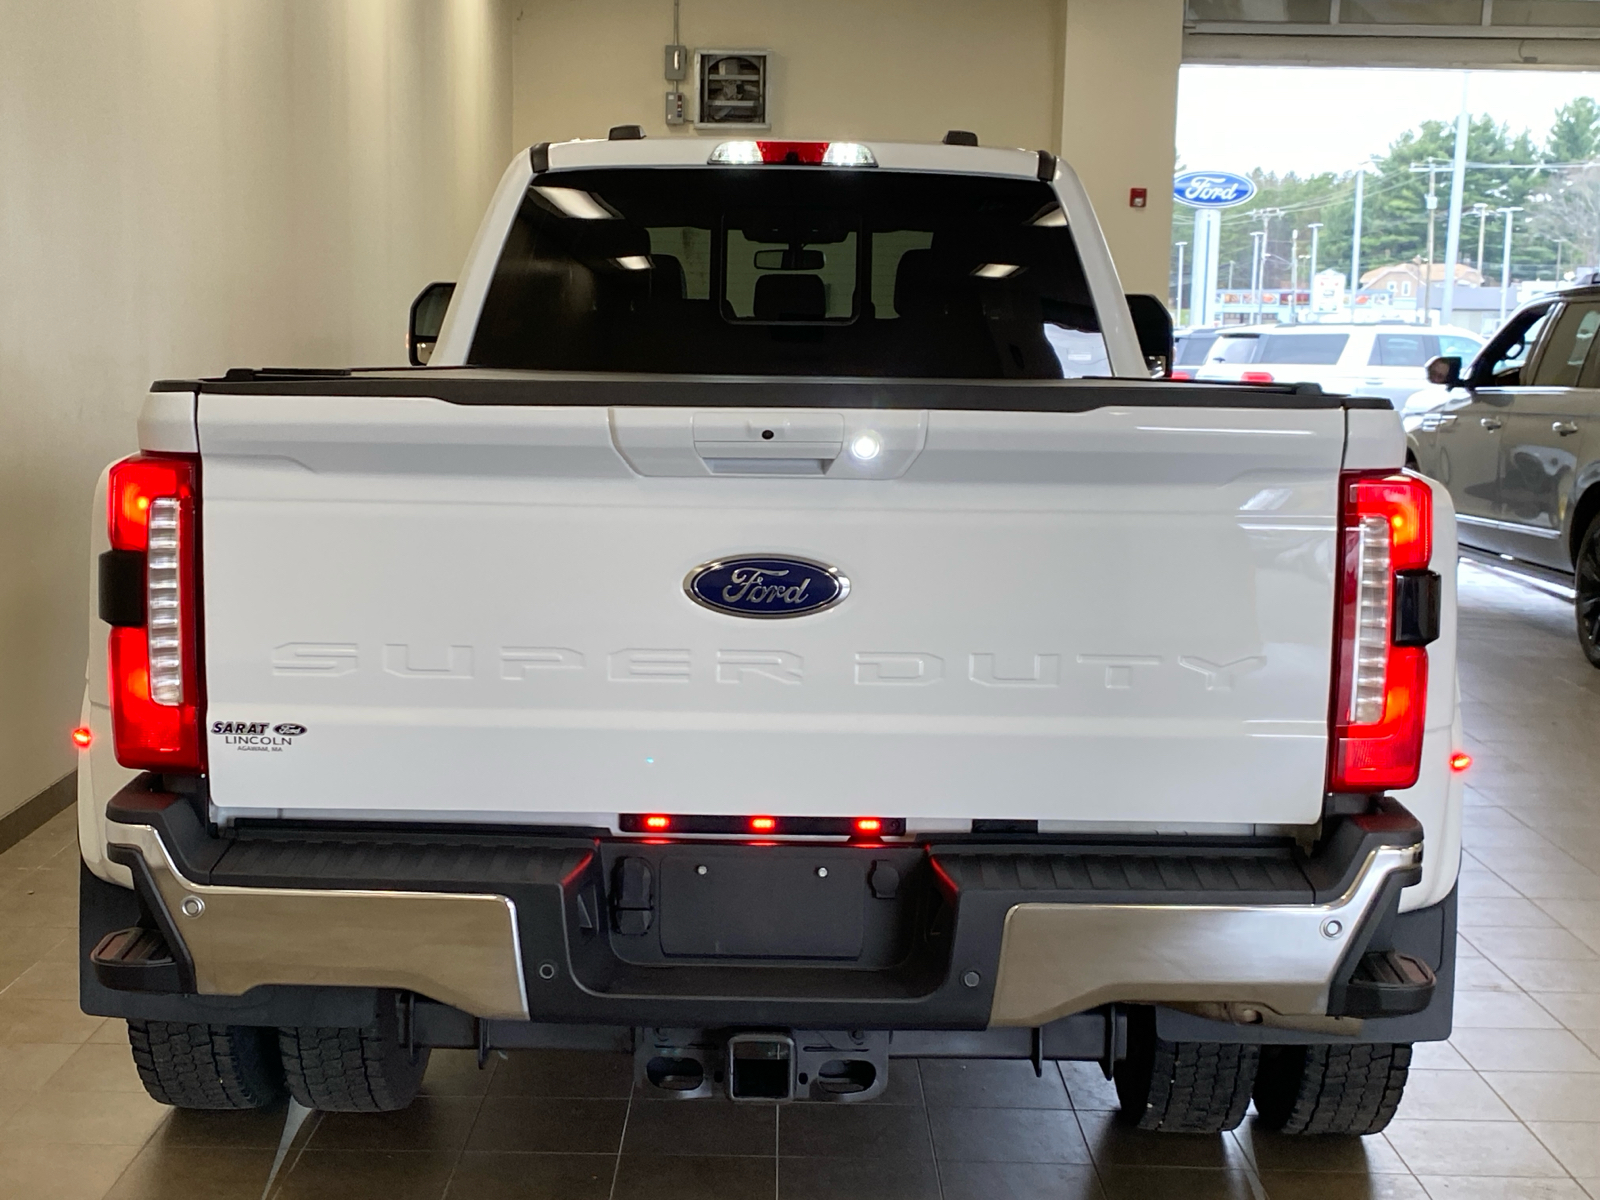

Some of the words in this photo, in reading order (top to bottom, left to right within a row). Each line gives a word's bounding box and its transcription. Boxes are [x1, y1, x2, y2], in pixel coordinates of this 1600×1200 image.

[1185, 176, 1239, 200] Ford
[722, 567, 811, 604] Ford
[271, 641, 804, 685] SUPER
[854, 651, 1268, 692] DUTY
[211, 721, 270, 735] SARAT
[225, 735, 292, 745] LINCOLN
